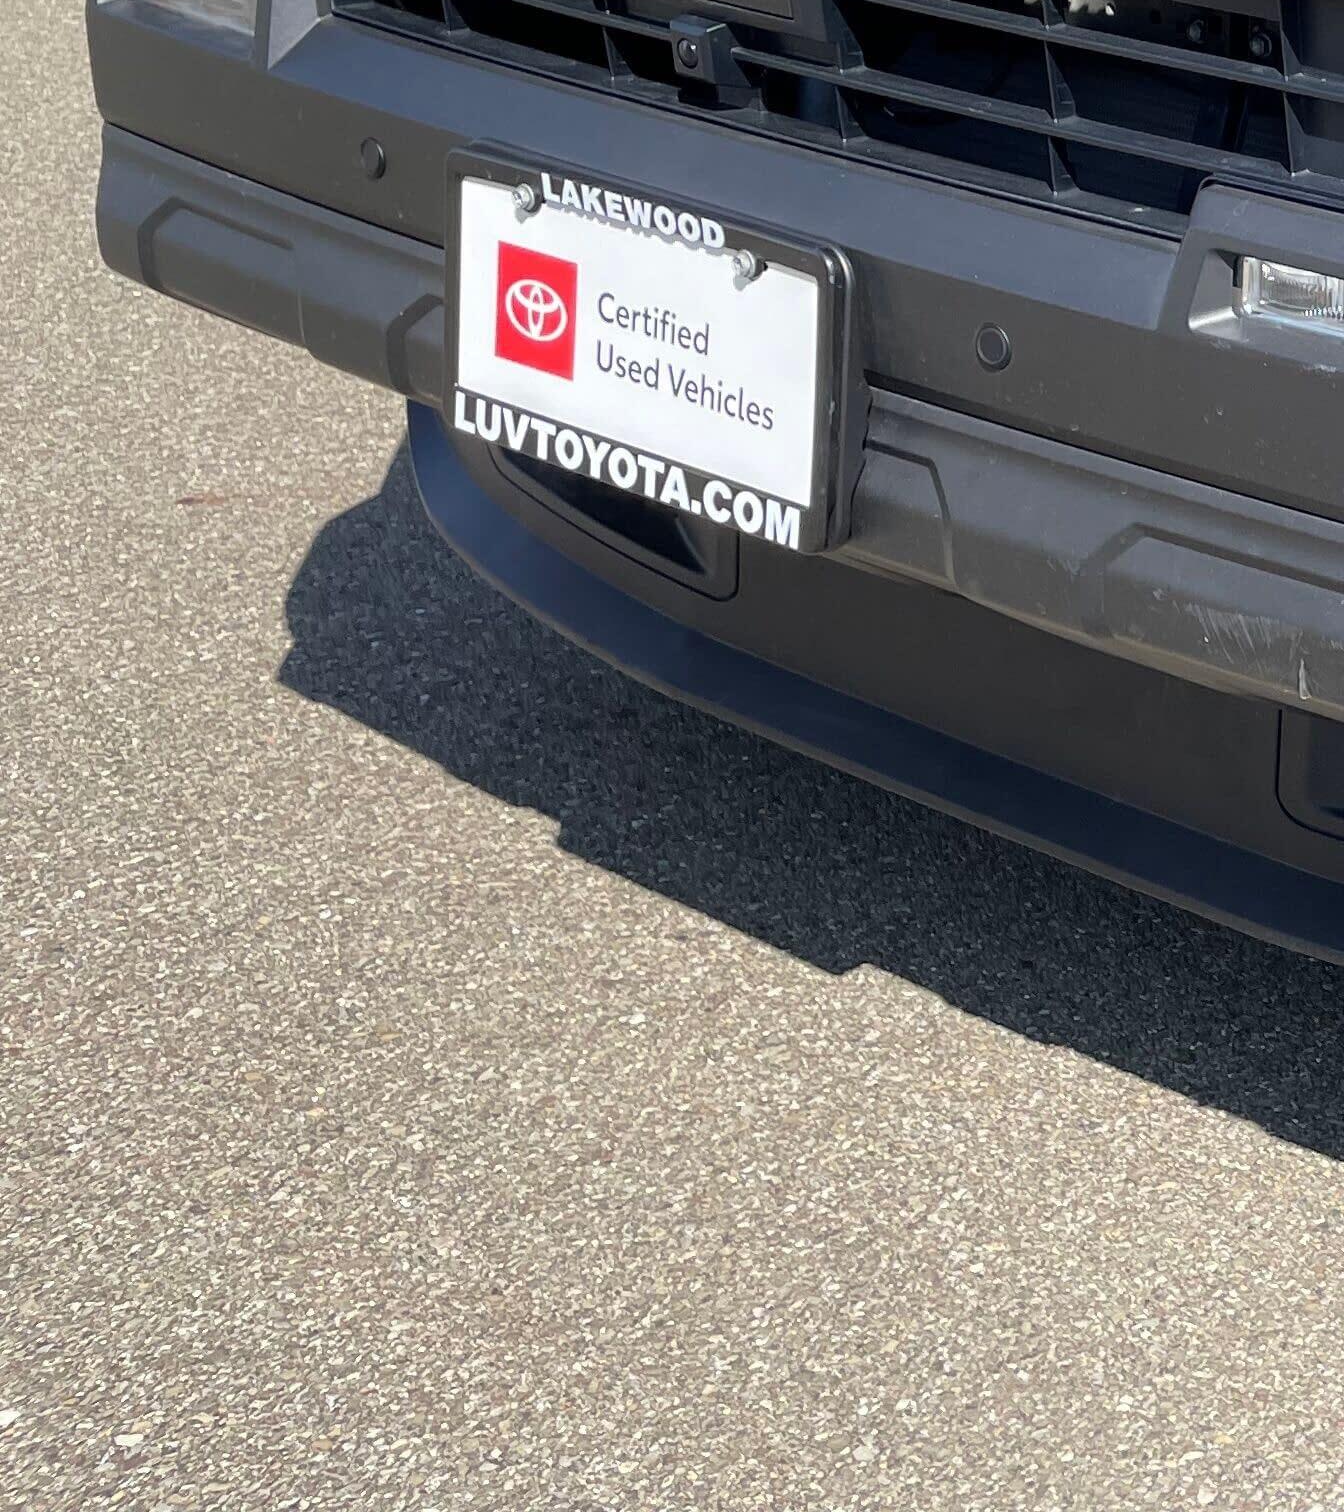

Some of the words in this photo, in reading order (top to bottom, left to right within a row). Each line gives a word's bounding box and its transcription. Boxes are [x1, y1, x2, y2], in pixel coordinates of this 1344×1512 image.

[540, 172, 726, 249] LAKEWOOD
[597, 291, 710, 356] Certified
[595, 338, 660, 391] Used
[668, 363, 775, 431] Vehicles
[454, 389, 800, 550] LUVTOYOTA.COM
